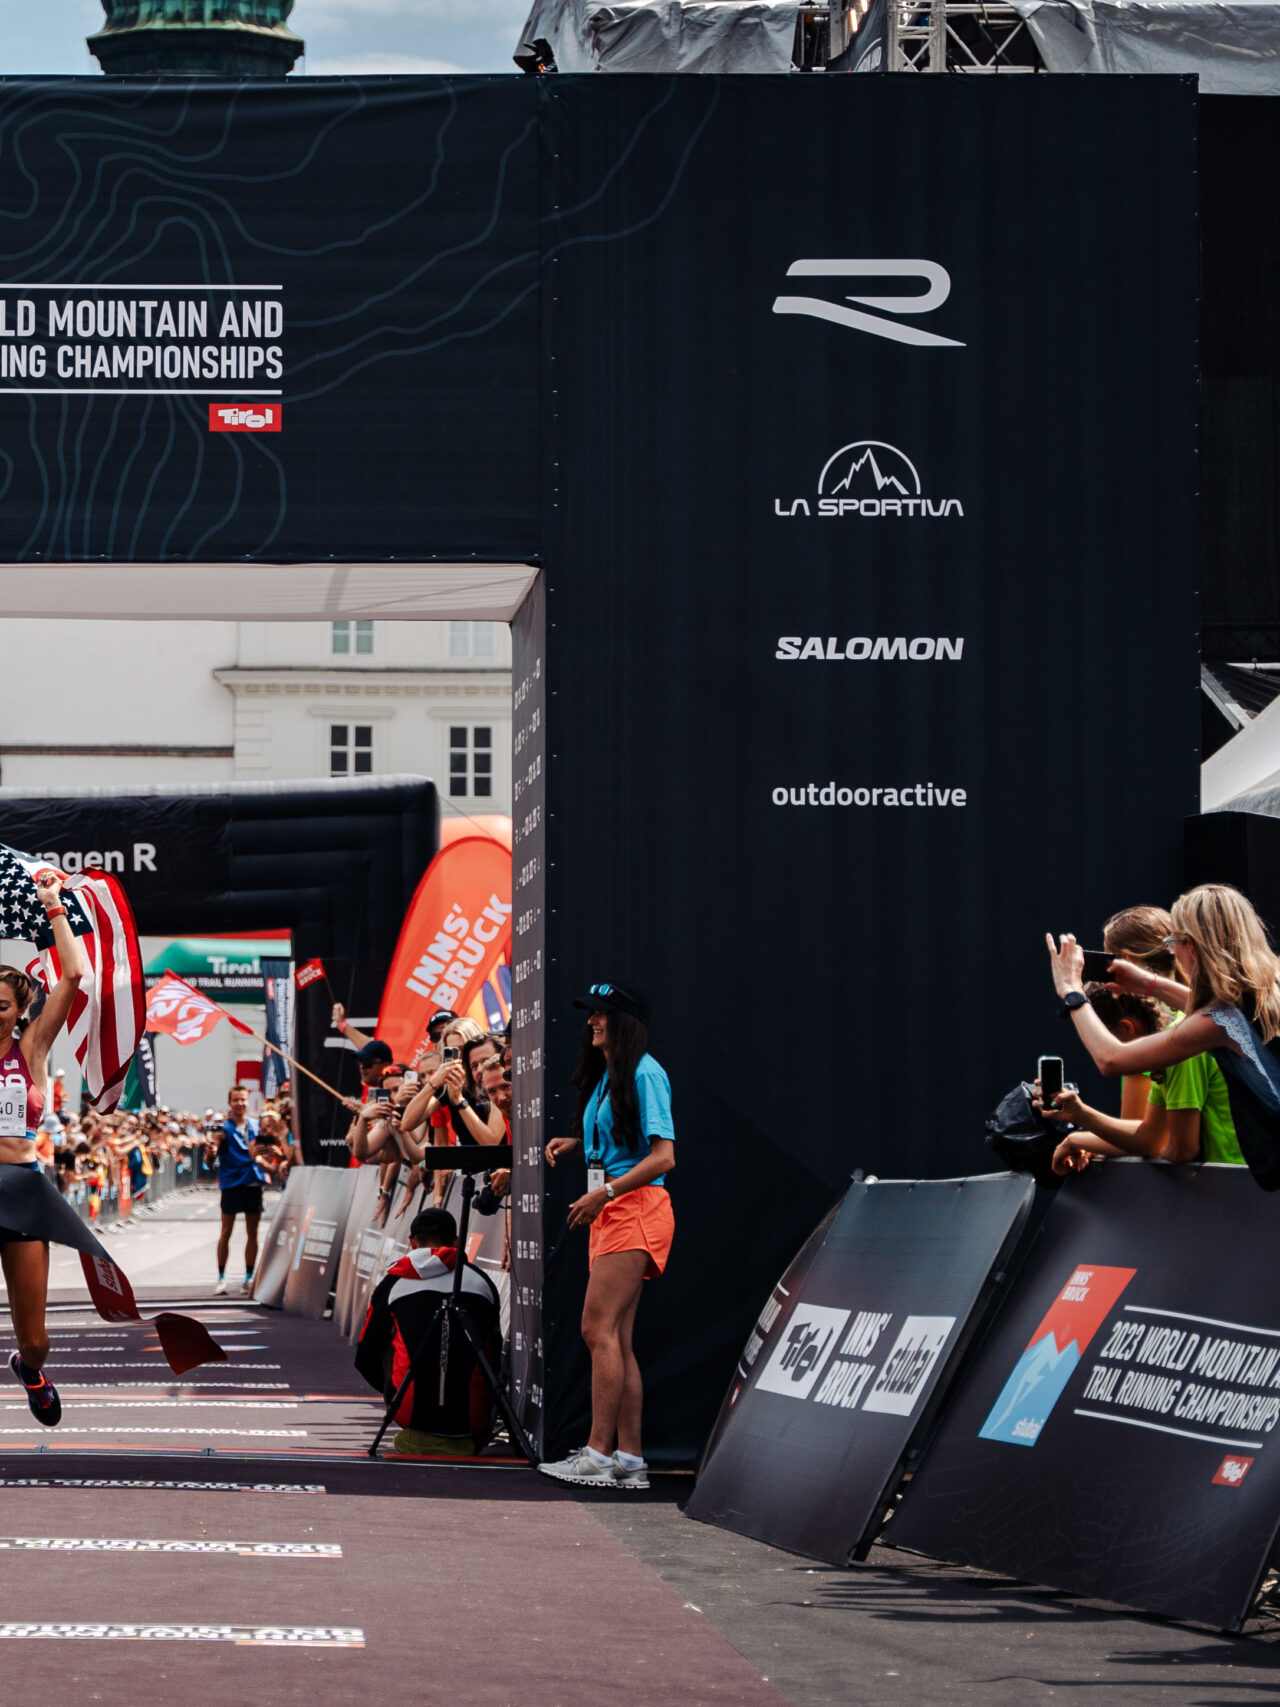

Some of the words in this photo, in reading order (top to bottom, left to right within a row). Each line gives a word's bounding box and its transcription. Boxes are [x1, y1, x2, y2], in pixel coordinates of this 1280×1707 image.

[48, 299, 208, 338] MOUNTAIN
[218, 300, 283, 338] AND
[57, 344, 283, 379] CHAMPIONSHIPS
[217, 408, 273, 428] Tirol
[774, 498, 811, 516] LA
[817, 498, 964, 517] SPORTIVA
[775, 636, 965, 661] SALOMON
[772, 781, 967, 807] outdooractive
[132, 842, 158, 873] R
[404, 902, 471, 999] INNS'
[430, 893, 513, 1011] BRUCK
[778, 1321, 834, 1383] Tirol
[839, 1310, 893, 1358] INNS'
[1099, 1320, 1147, 1362] 2023
[1135, 1326, 1201, 1371] WORLD
[813, 1359, 876, 1410] BRUCK
[874, 1333, 945, 1395] stubai
[1082, 1365, 1123, 1402] TRAIL
[1114, 1370, 1183, 1414] RUNNING
